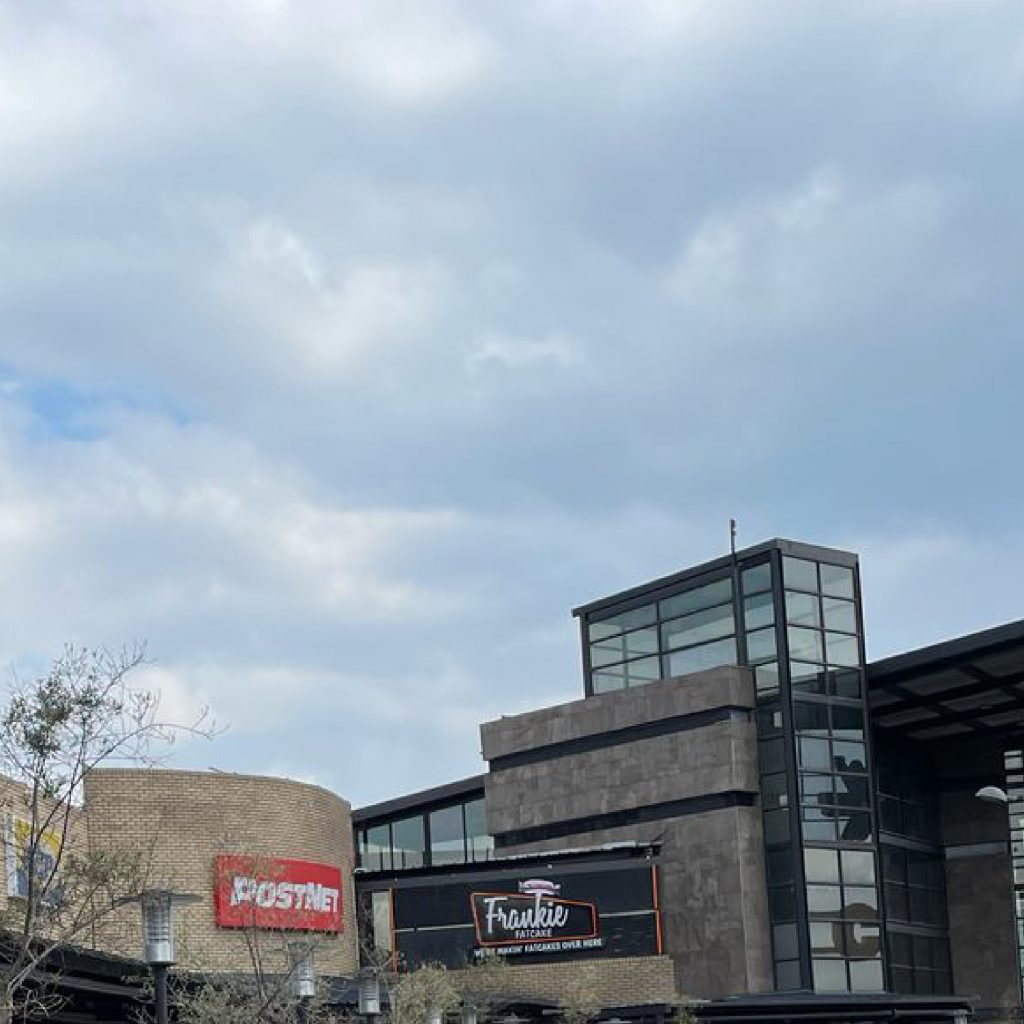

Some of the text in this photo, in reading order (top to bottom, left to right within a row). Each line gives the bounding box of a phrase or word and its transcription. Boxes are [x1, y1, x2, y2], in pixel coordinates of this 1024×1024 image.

[231, 876, 338, 913] POSTNET
[484, 893, 570, 934] Frankie
[515, 929, 553, 938] FATCAKE
[562, 940, 582, 950] OVER
[583, 938, 603, 948] HERE
